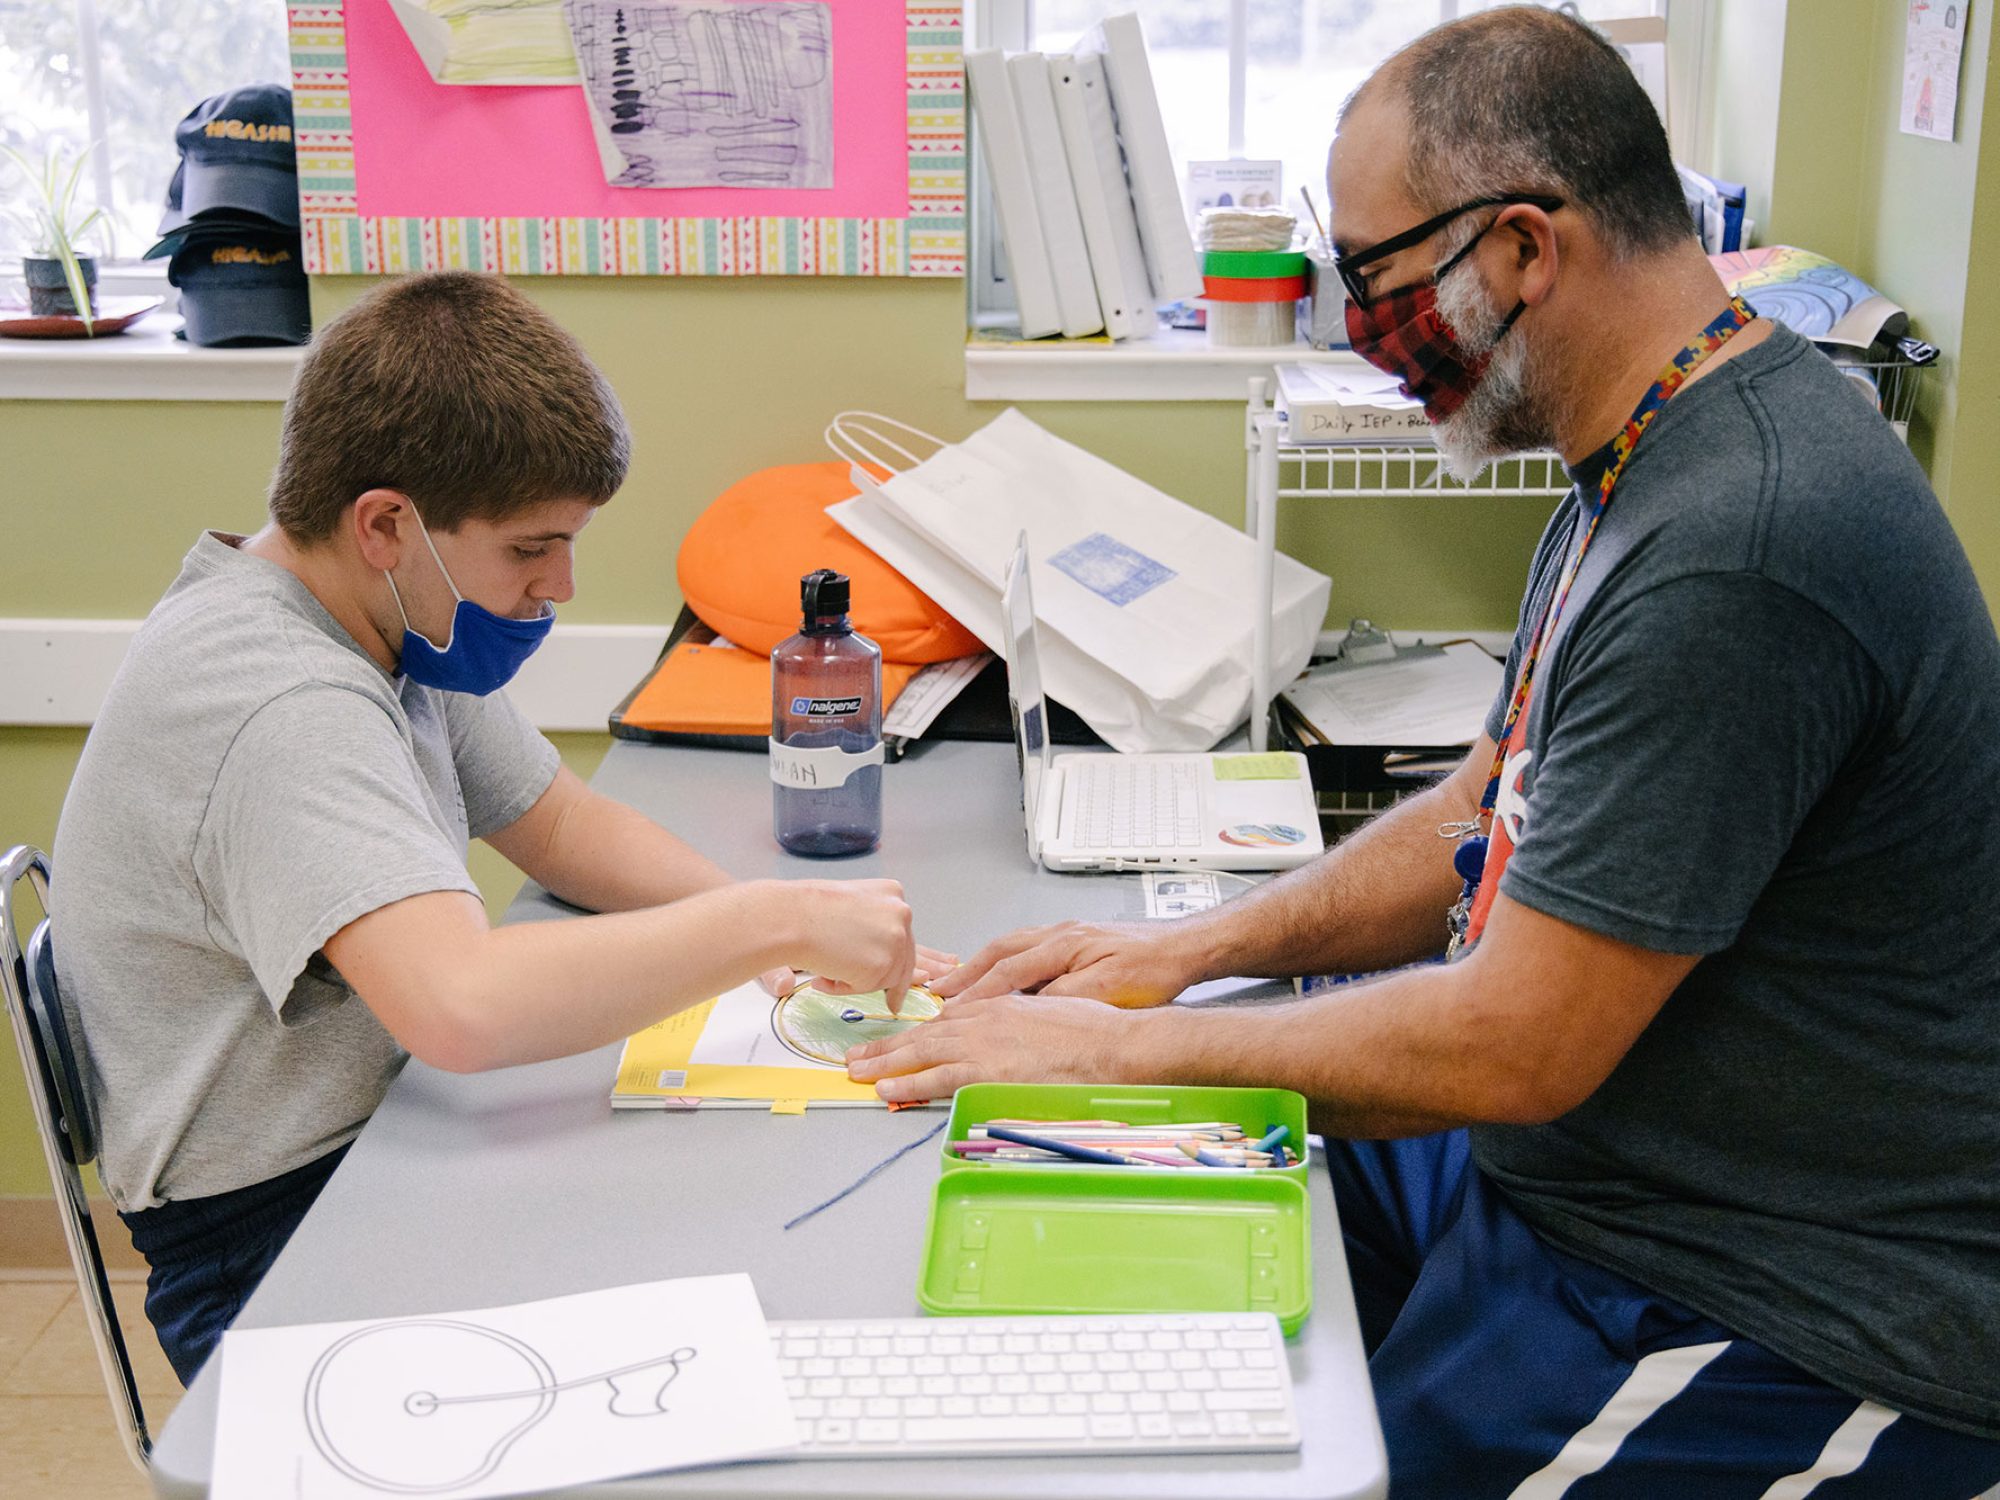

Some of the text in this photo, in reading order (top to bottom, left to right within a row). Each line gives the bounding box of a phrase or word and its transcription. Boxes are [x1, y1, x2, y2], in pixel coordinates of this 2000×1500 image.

[205, 119, 292, 142] HIGASHI
[1312, 414, 1354, 433] Daily
[1360, 413, 1393, 428] IEP
[810, 700, 860, 714] nalgene
